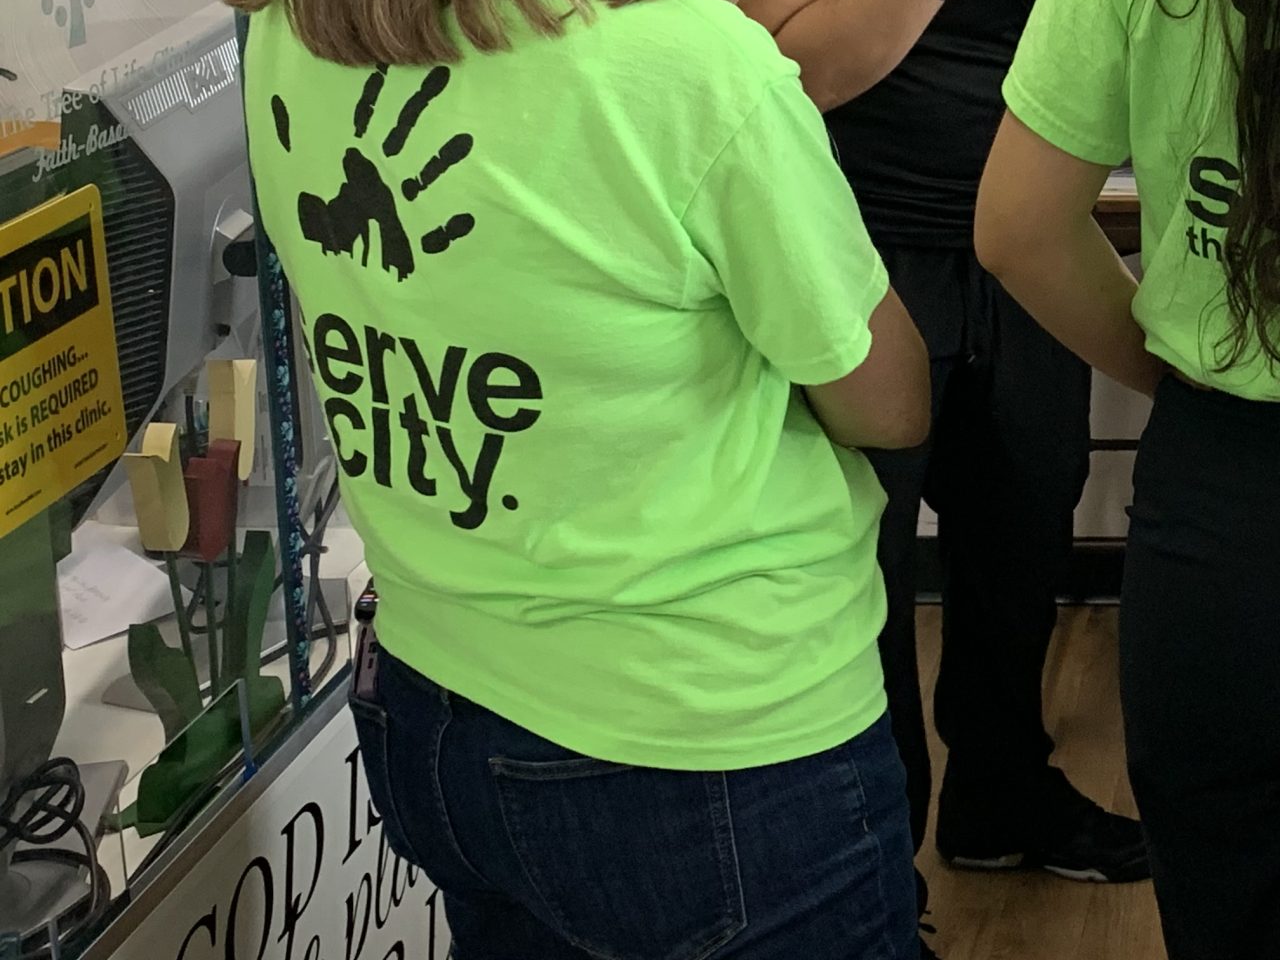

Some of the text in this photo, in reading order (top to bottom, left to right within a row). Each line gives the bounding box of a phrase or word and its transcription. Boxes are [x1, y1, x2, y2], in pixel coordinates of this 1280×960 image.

[40, 87, 83, 120] Tree
[89, 70, 107, 105] of
[110, 58, 145, 89] Life
[16, 415, 28, 437] is
[30, 368, 99, 428] REQUIRED
[301, 308, 543, 433] erve
[31, 442, 45, 464] in
[47, 424, 73, 452] this
[75, 398, 112, 435] clinic.
[324, 392, 519, 530] city.
